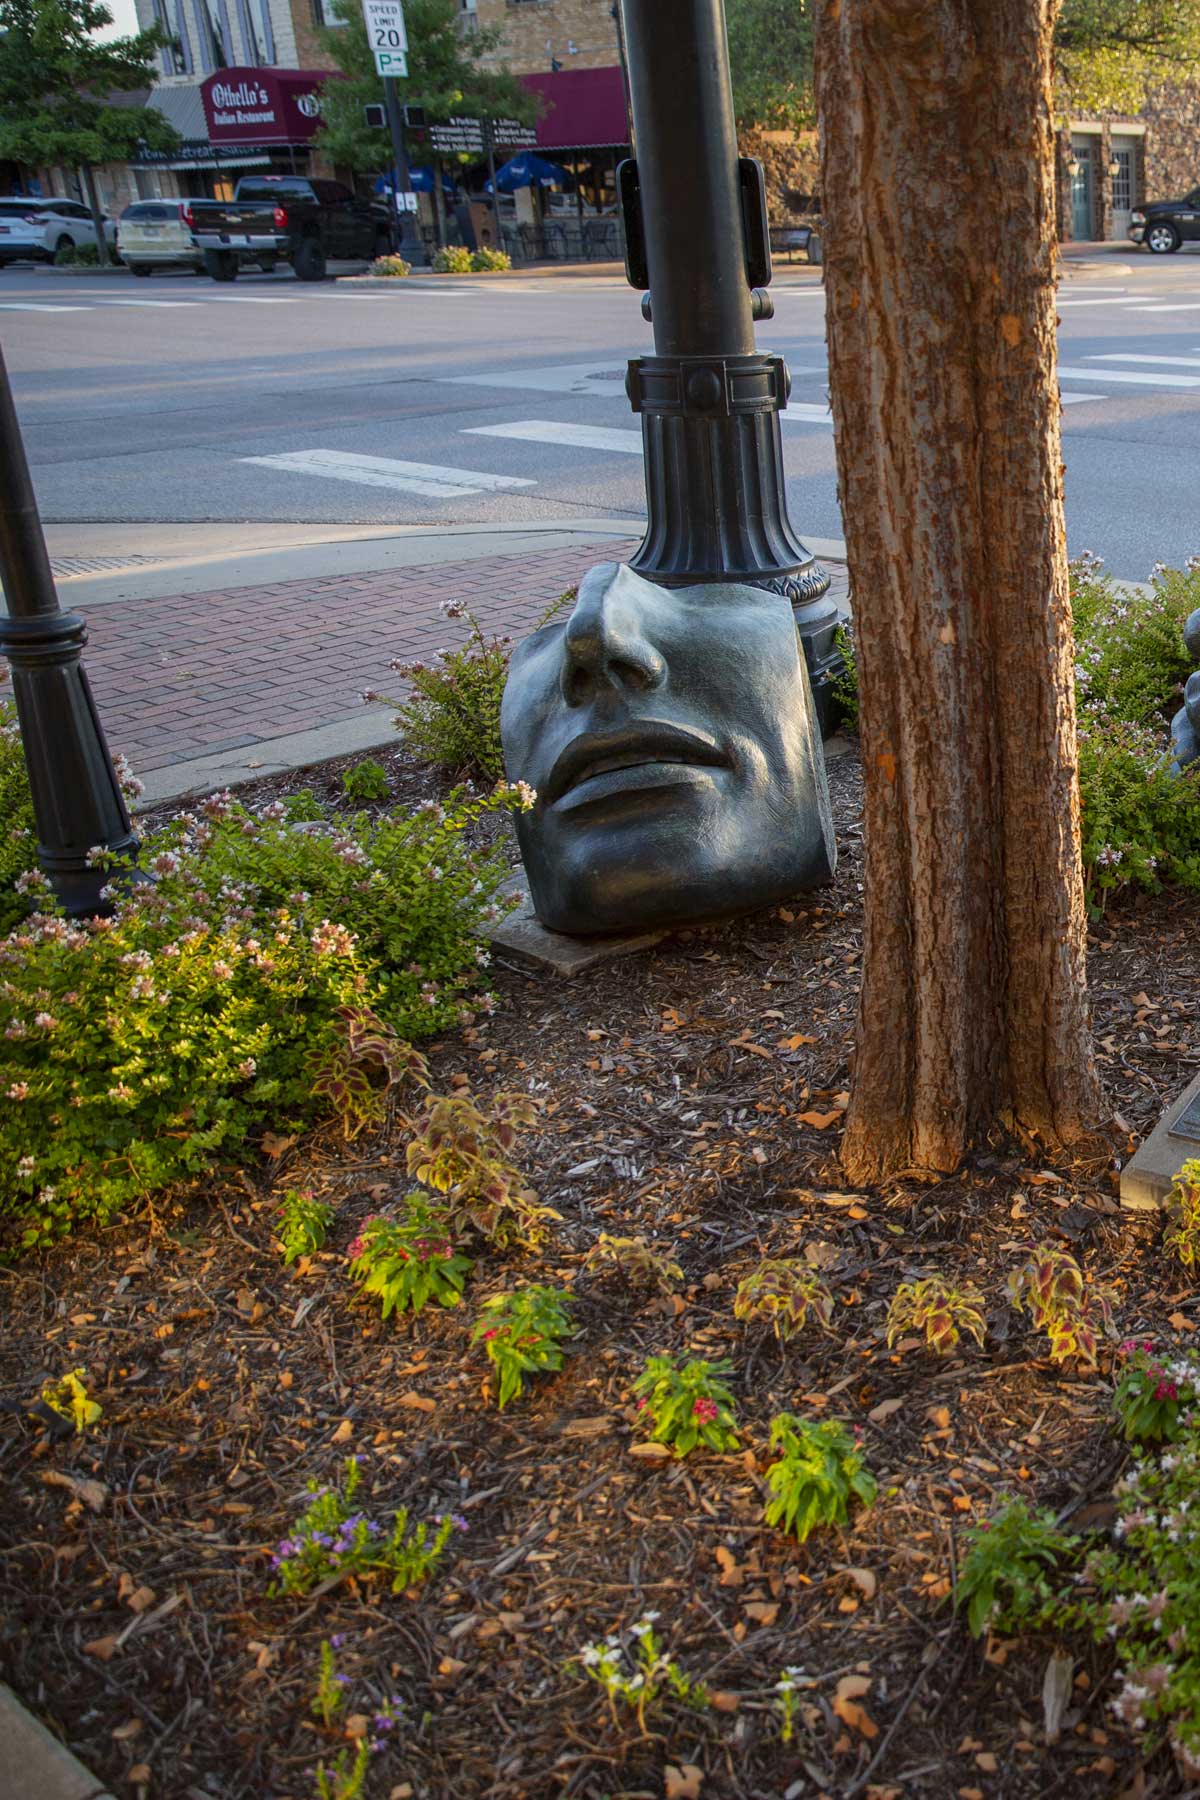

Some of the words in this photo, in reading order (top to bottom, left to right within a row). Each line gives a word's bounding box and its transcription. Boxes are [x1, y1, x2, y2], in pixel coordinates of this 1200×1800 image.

[369, 5, 398, 14] SPEED
[374, 17, 396, 26] LIMIT
[375, 29, 400, 47] 20
[212, 82, 269, 109] Othello's
[214, 111, 236, 125] Italian
[236, 110, 275, 124] Restaurant
